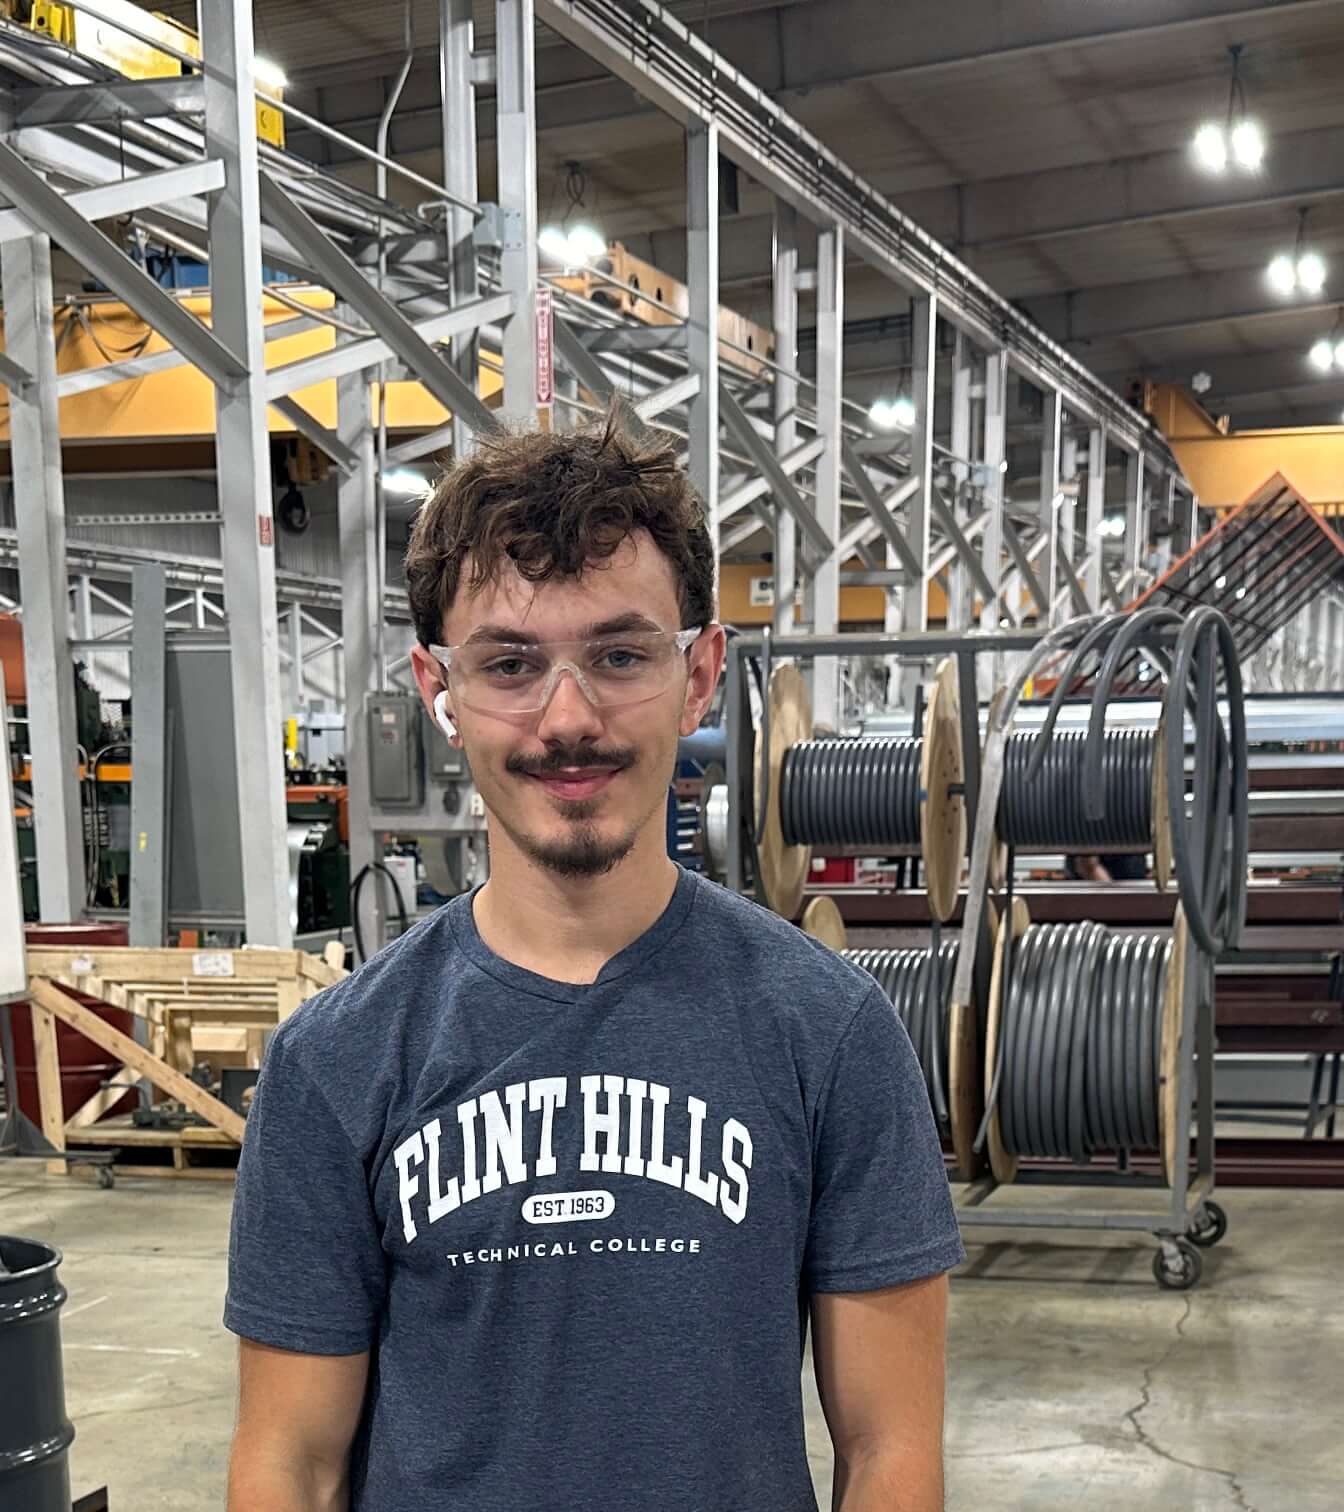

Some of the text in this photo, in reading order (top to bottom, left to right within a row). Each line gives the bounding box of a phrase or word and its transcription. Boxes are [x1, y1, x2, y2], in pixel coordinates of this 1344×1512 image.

[394, 1075, 753, 1243] FLINT HILLS
[570, 1197, 605, 1214] 1963
[447, 1239, 701, 1266] TECHNICAL COLLEGE
